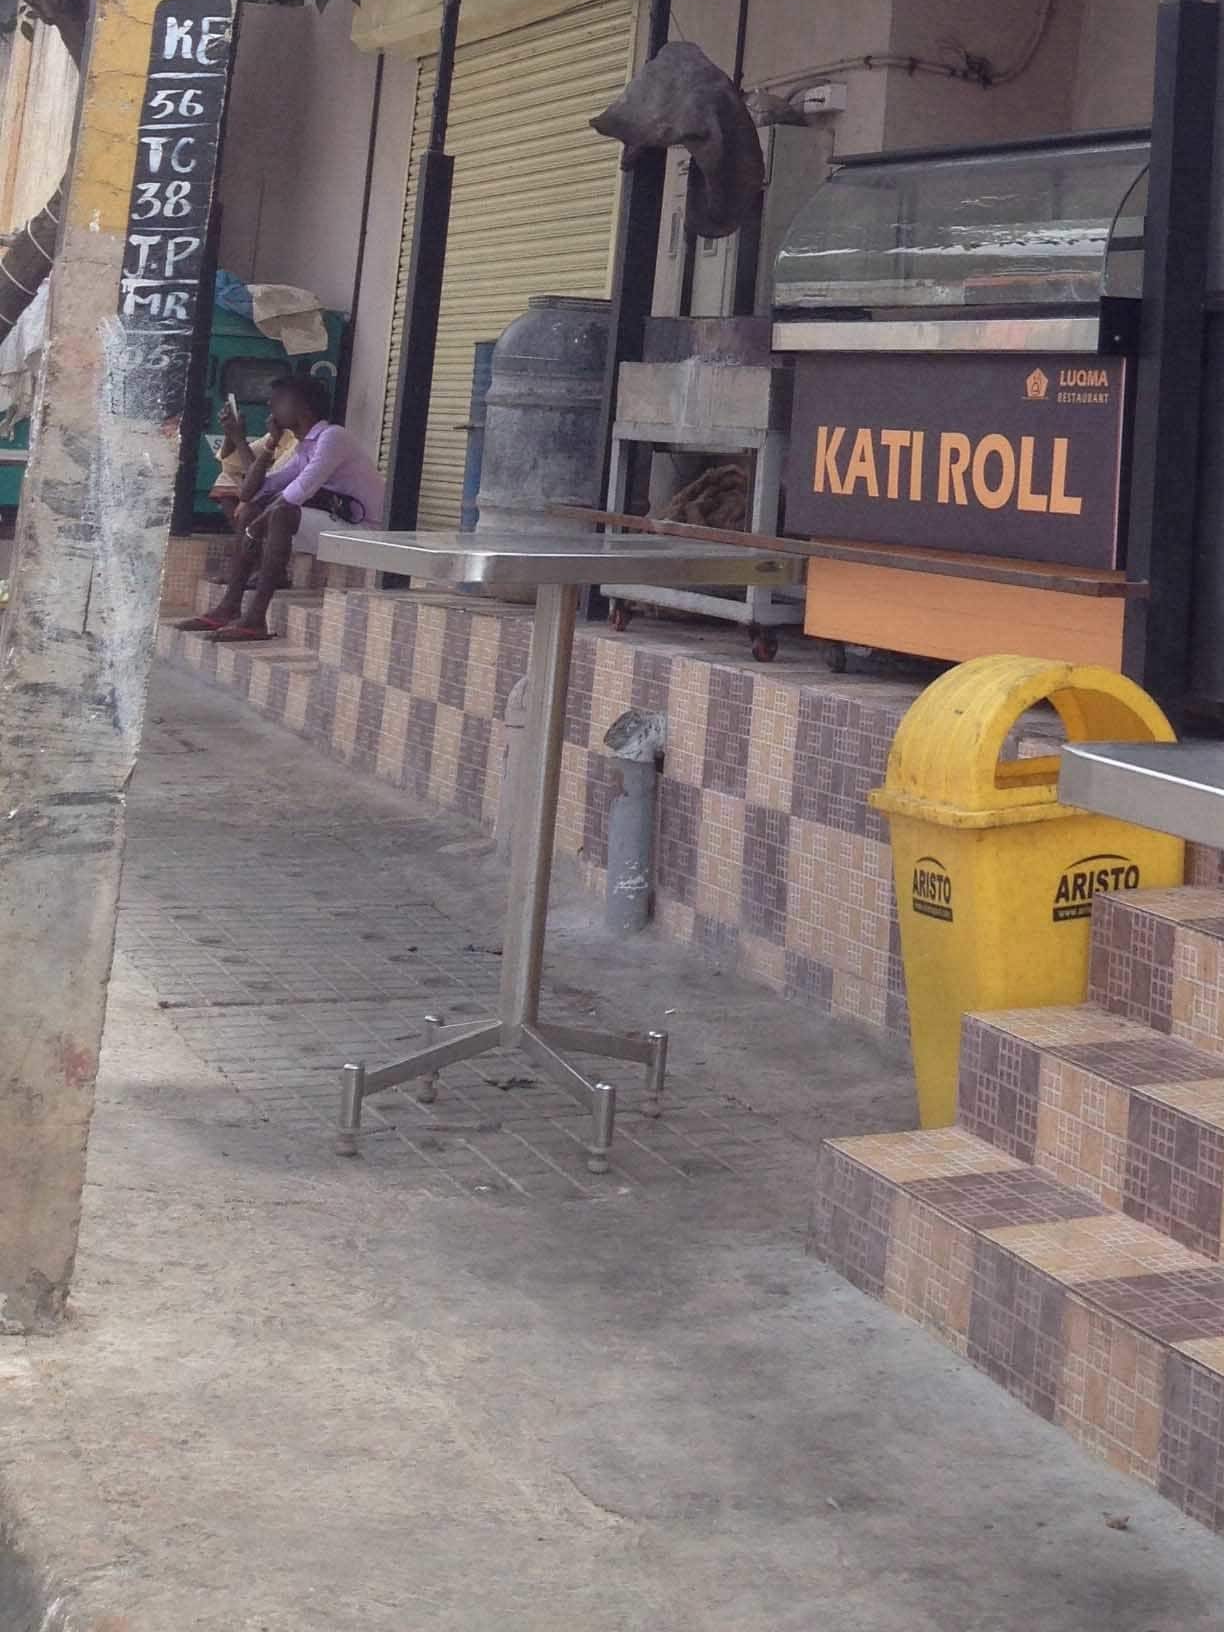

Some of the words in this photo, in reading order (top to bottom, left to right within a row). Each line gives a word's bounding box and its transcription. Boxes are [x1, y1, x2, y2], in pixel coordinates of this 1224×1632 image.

[149, 88, 204, 119] 56
[140, 136, 197, 174] TC
[131, 180, 191, 220] 38
[121, 288, 190, 320] MR
[1059, 370, 1109, 387] LUQMA
[813, 426, 925, 502] KATI
[937, 431, 1083, 516] ROLL
[912, 867, 951, 905] ARISTO
[1055, 864, 1139, 904] ARISTO
